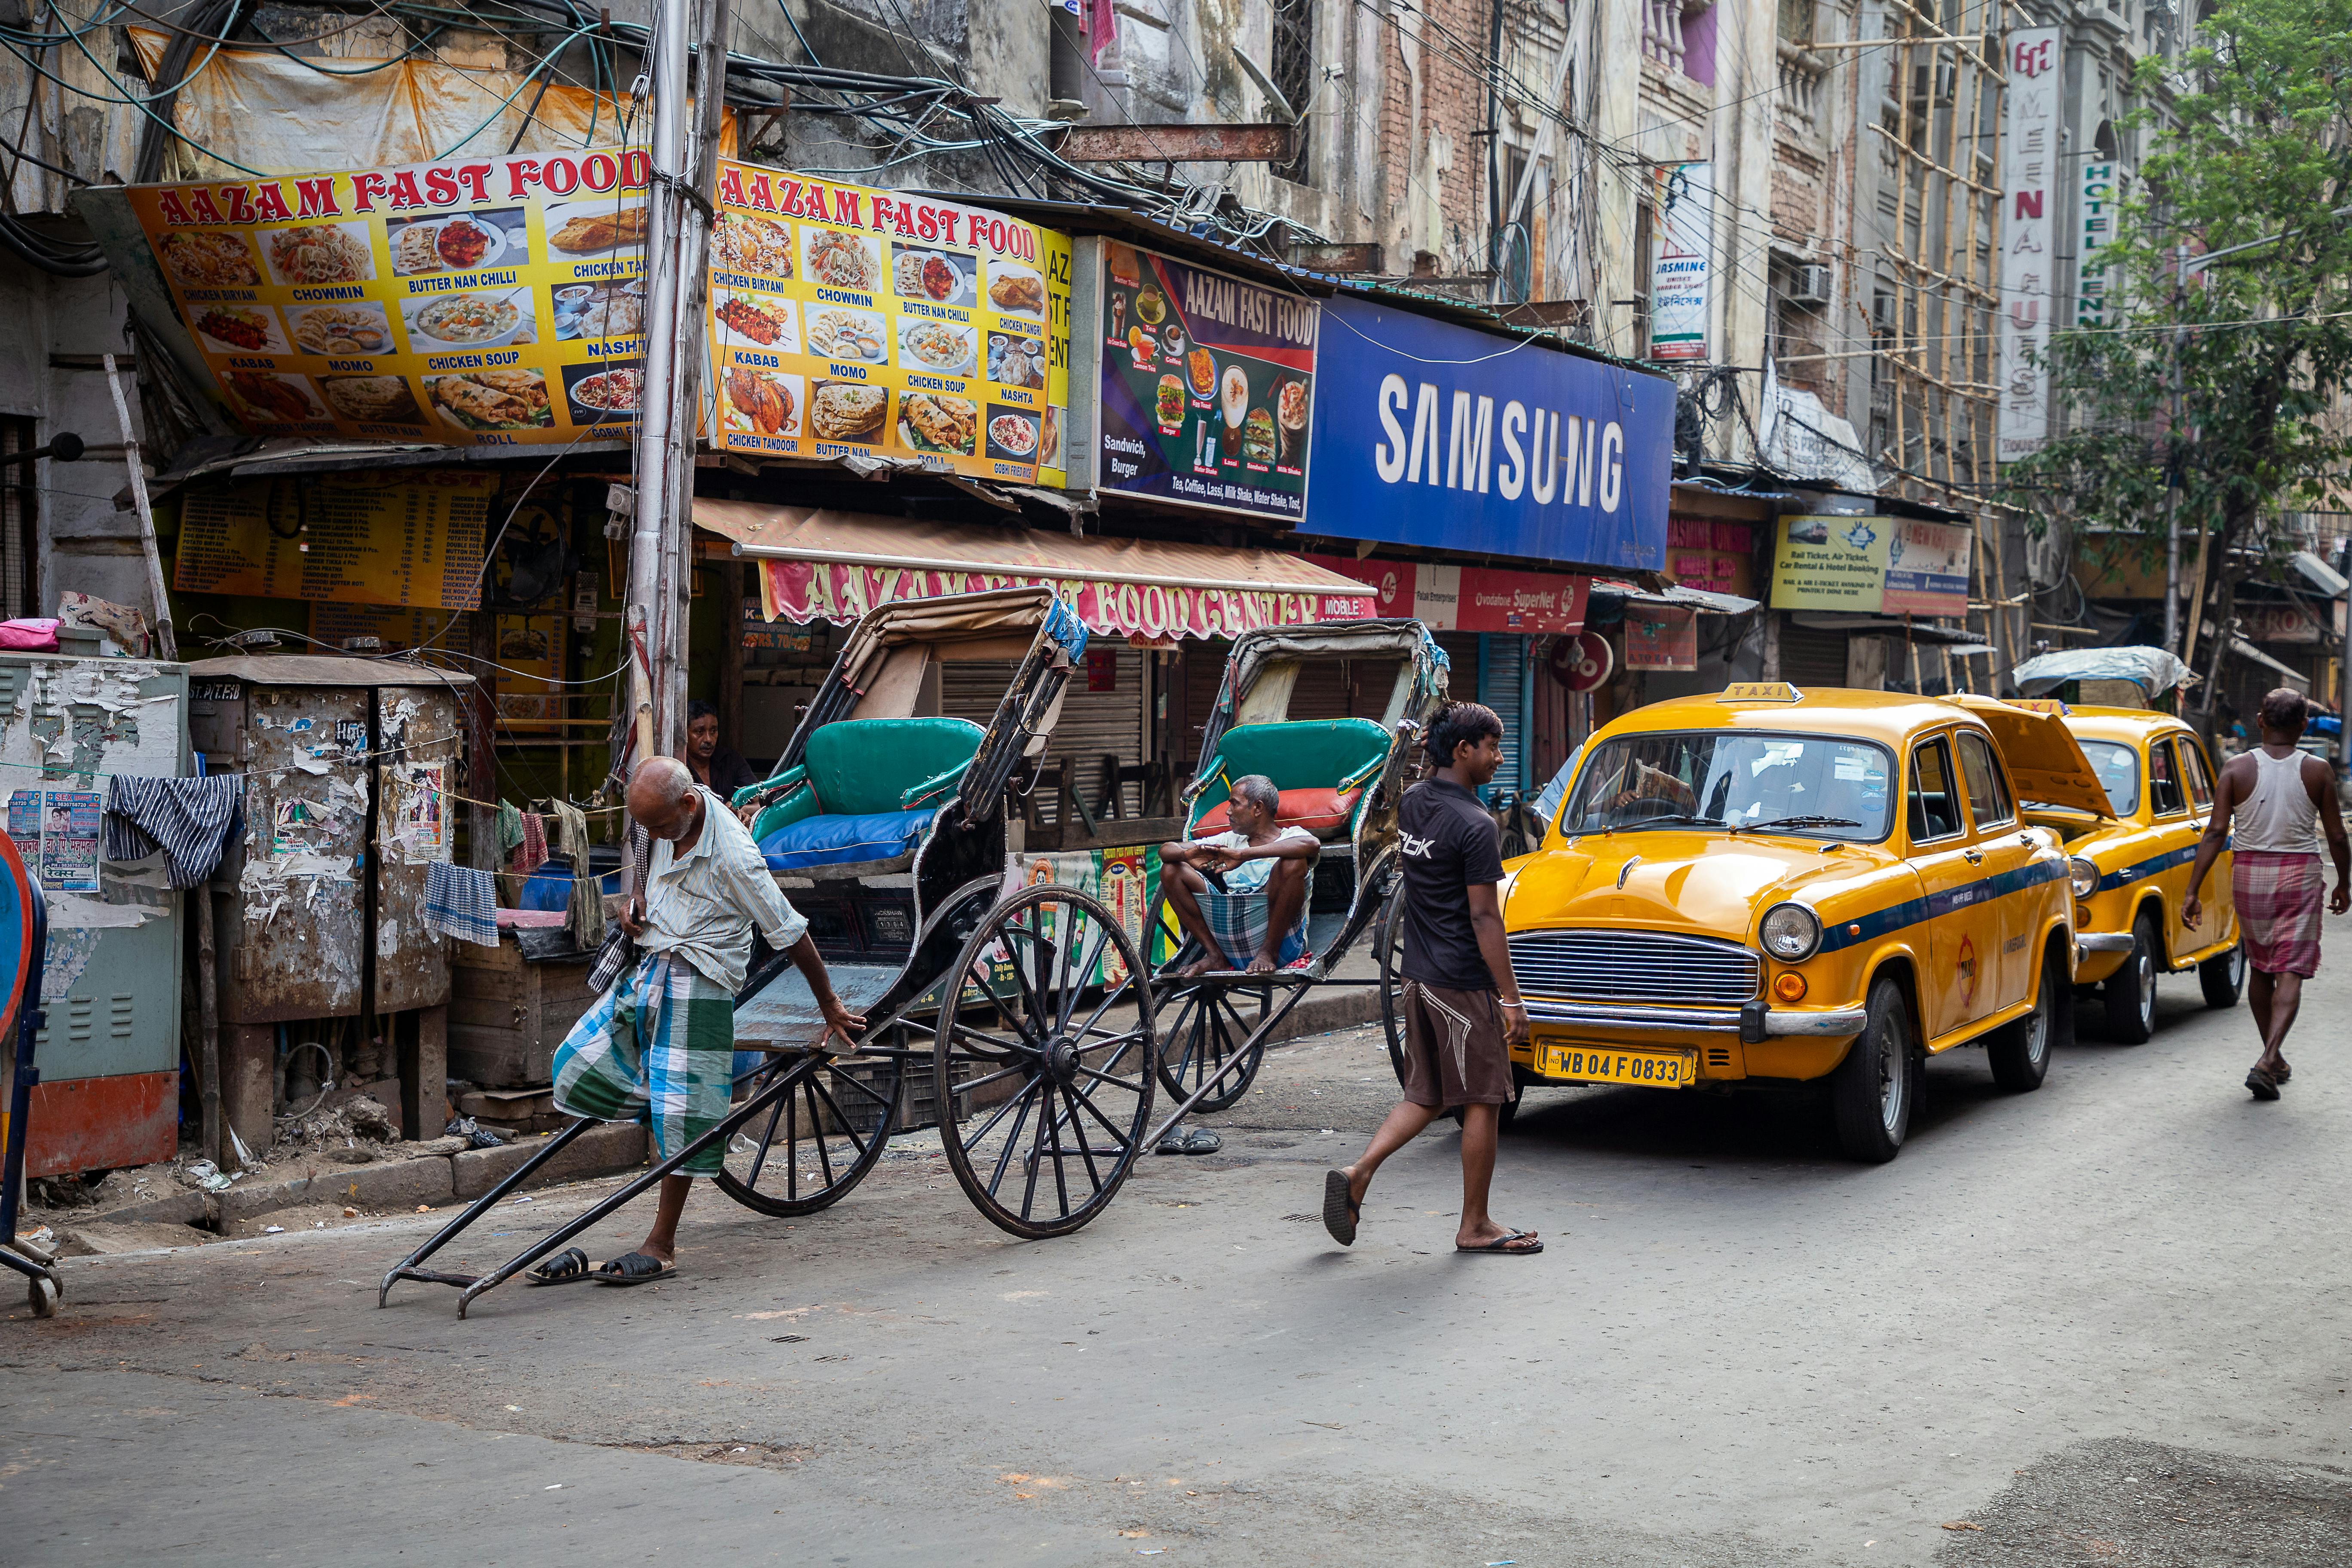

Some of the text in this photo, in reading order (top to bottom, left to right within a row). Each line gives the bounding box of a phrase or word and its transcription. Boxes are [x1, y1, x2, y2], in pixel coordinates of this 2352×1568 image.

[159, 149, 652, 227] AAZAM FAST FOOD
[720, 166, 1035, 263] AAZAM FAST FOOD
[2084, 165, 2111, 250] HOTEL
[574, 262, 624, 278] CHICKEN
[1049, 250, 1071, 285] AZ
[1656, 262, 1706, 274] JASMINE
[409, 270, 517, 293] BUTTER NAN CHILLI
[714, 271, 784, 294] CHICKEN BIRYANI
[184, 289, 257, 302] CHICKEN BIRYANI
[292, 285, 364, 301] CHOWMIN
[817, 289, 873, 307] CHOWMIN
[903, 302, 969, 322] BUTTER NAN CHILLI
[1185, 270, 1314, 346] AAZAM FAST FOOD
[1000, 317, 1042, 336] CHICKEN TANGRI
[1145, 325, 1156, 333] Tea
[229, 358, 276, 370] KABAB
[328, 360, 374, 372] MOMO
[429, 351, 520, 370] CHICKEN SOUP
[735, 351, 779, 368] KABAB
[1133, 362, 1148, 370] Lemon
[1165, 356, 1182, 365] Coffee
[830, 364, 867, 380] MOMO
[908, 374, 965, 393] CHICKEN SOUP
[1001, 388, 1033, 404] NASHTA
[1192, 399, 1212, 410] Egg Toast
[358, 424, 423, 437] BUTTER NAN
[591, 427, 625, 438] GOBHI
[476, 433, 518, 445] ROLL
[727, 433, 798, 453] CHICKEN TANDOORI
[1105, 434, 1145, 458] Sandwich,
[1375, 373, 1623, 513] SAMSUNG
[816, 443, 870, 457] BUTTER NAN
[994, 462, 1032, 478] GOBHI FRIED RICE
[1112, 458, 1138, 478] Burger
[1247, 462, 1268, 472] Sandwich
[1173, 476, 1301, 512] Tea, Lassi, Milk Shake, Water Shake, Tost,
[1791, 551, 1805, 559] Rail
[1807, 551, 1830, 560] Ticket,
[1845, 553, 1869, 562] Ticket,
[1847, 564, 1879, 575] Booking
[1383, 579, 1396, 596] 4G
[805, 563, 1318, 634] AAZAM FOOD CENTER
[1430, 591, 1457, 604] Enterprises
[1482, 588, 1555, 611] vodafone SuperNet
[745, 609, 755, 619] K
[1325, 600, 1359, 615] MOBILE
[766, 624, 791, 633] POPCORN
[758, 633, 774, 647] RS.
[1734, 686, 1782, 695] TAXI
[70, 838, 97, 860] मजुमदार
[46, 867, 77, 878] रेक्स
[1960, 957, 1973, 980] TAXI
[1561, 1052, 1679, 1082] WB 04 F 0833
